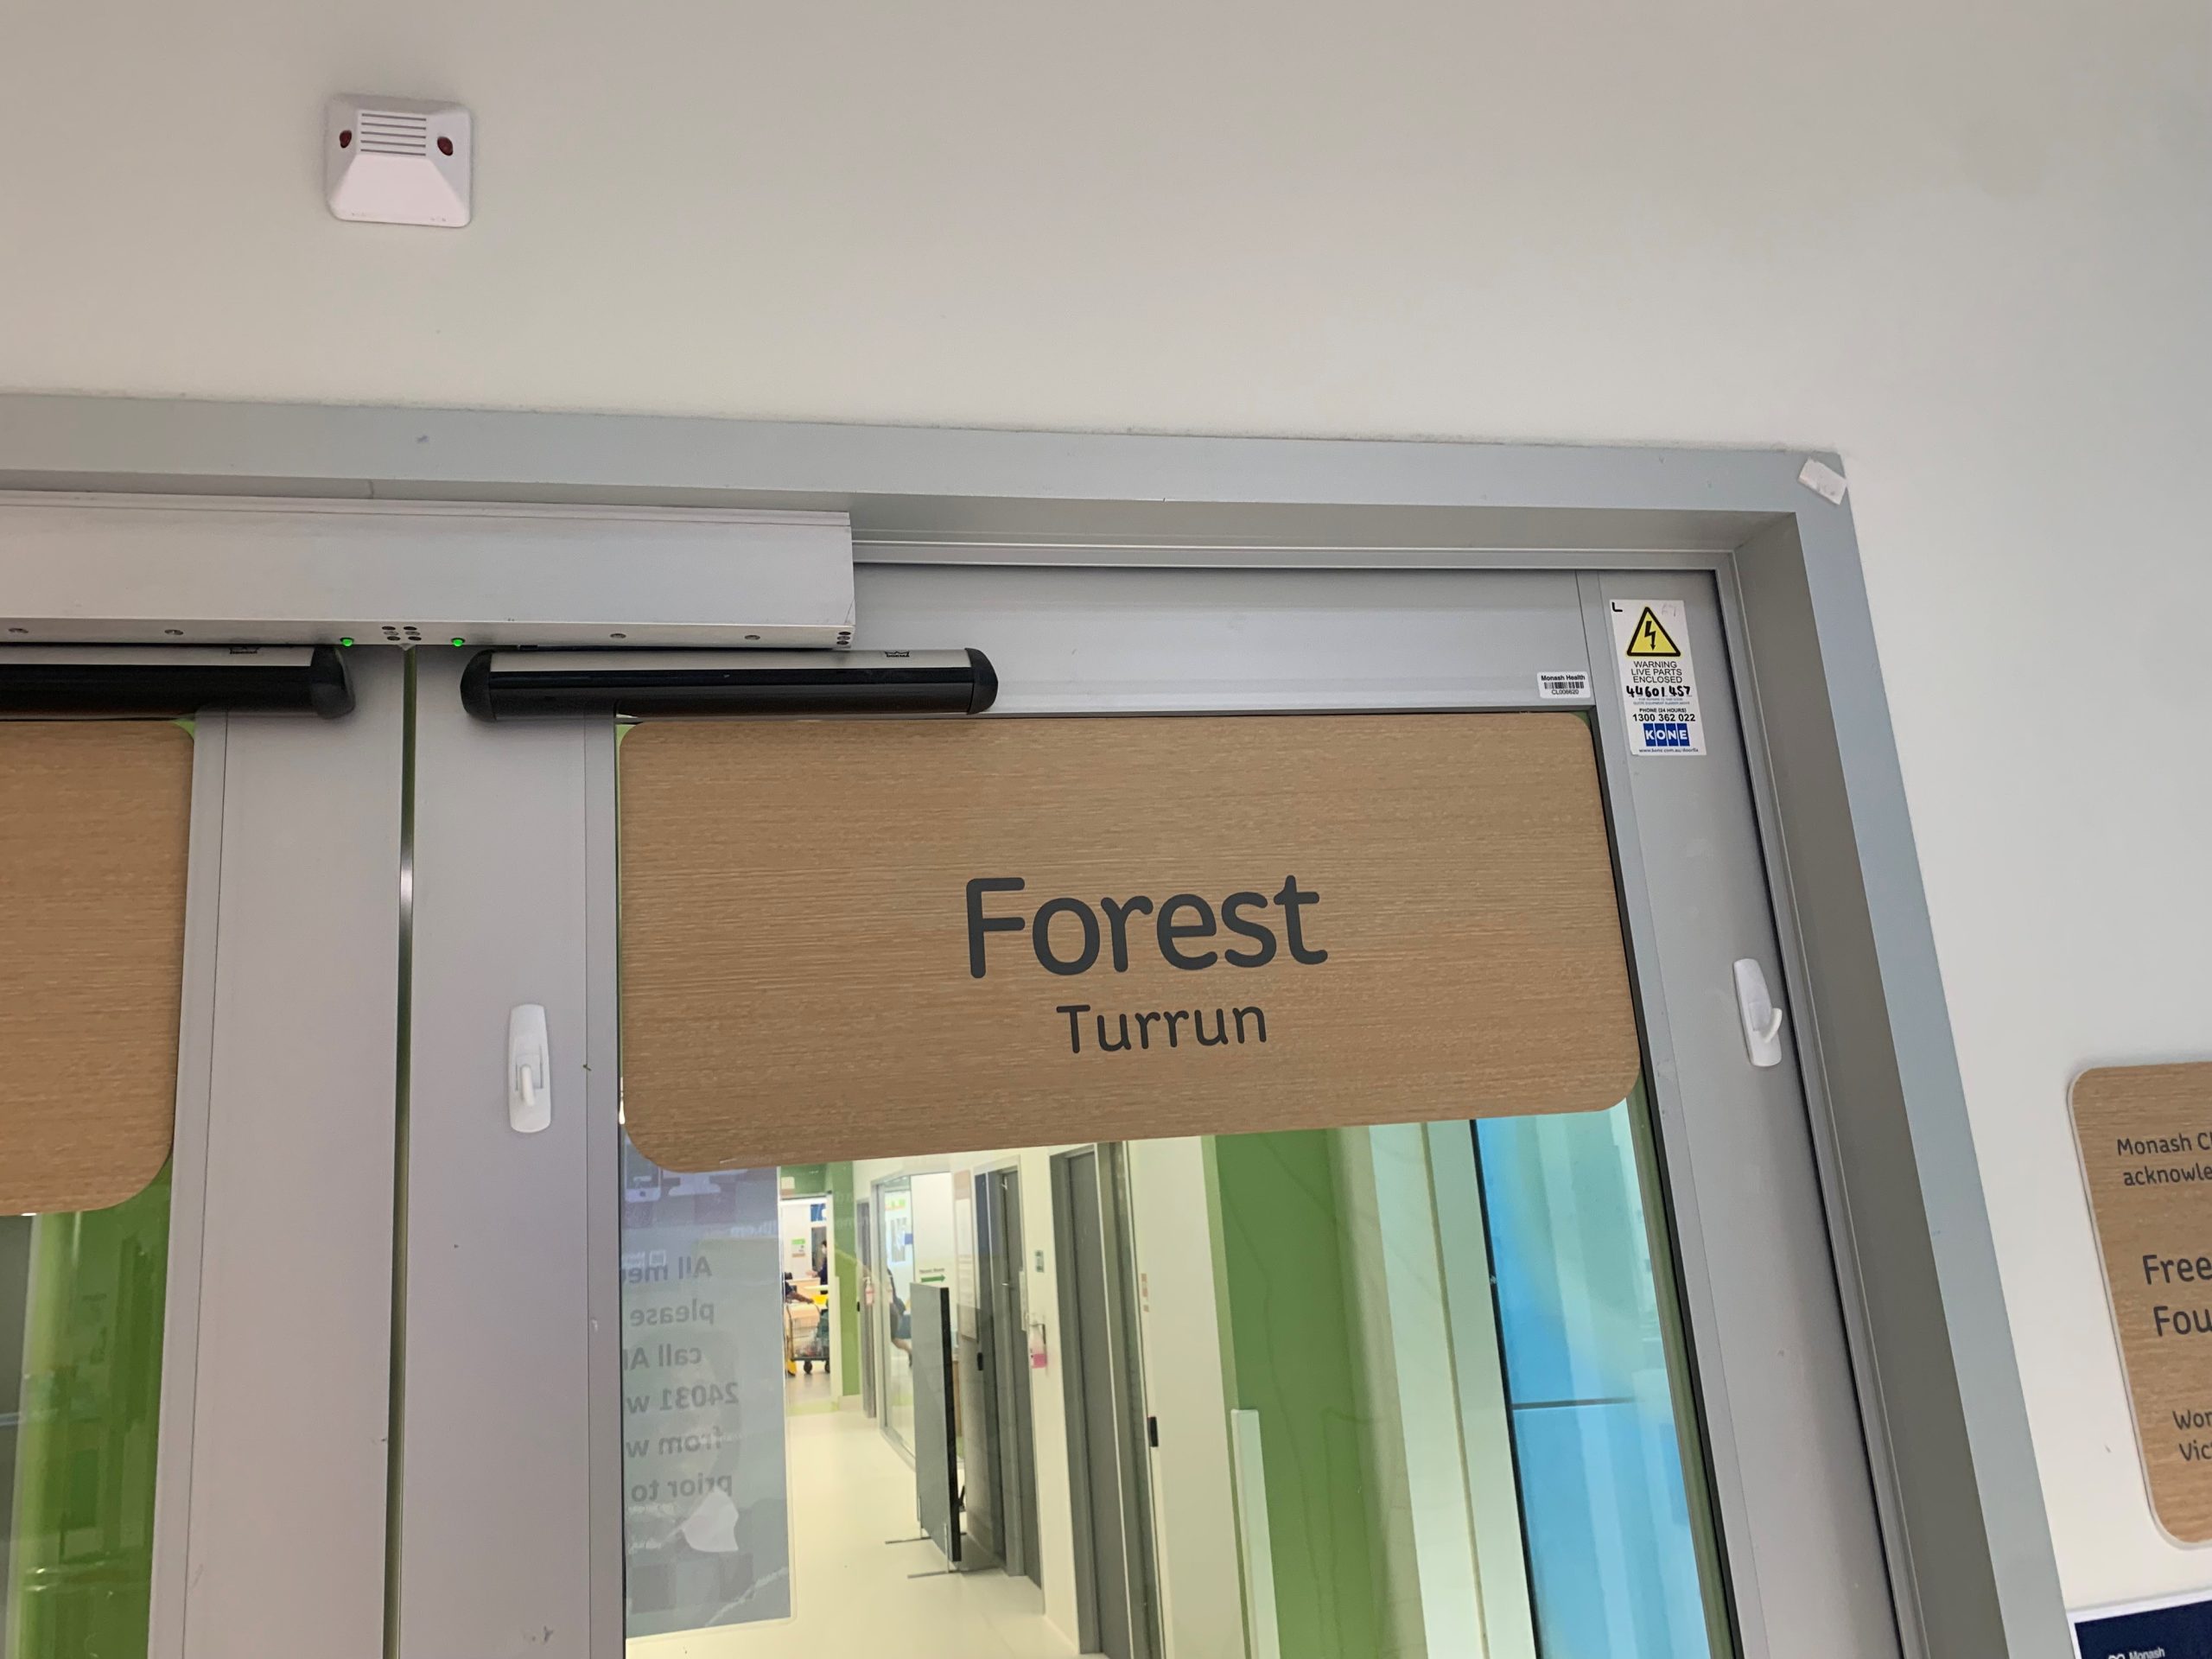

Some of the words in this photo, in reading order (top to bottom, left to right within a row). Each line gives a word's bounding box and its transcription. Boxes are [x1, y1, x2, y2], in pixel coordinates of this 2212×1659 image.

[1678, 713, 1696, 721] 022
[1645, 729, 1688, 741] KONE
[965, 874, 1329, 979] Forest
[1055, 1004, 1267, 1054] Turrun
[2117, 1132, 2192, 1156] Monash
[2123, 1162, 2212, 1186] acknowle
[2142, 1255, 2212, 1285] Free
[2153, 1306, 2212, 1337] Fou
[2178, 1439, 2212, 1462] Vic
[2128, 1646, 2165, 1659] Monash
